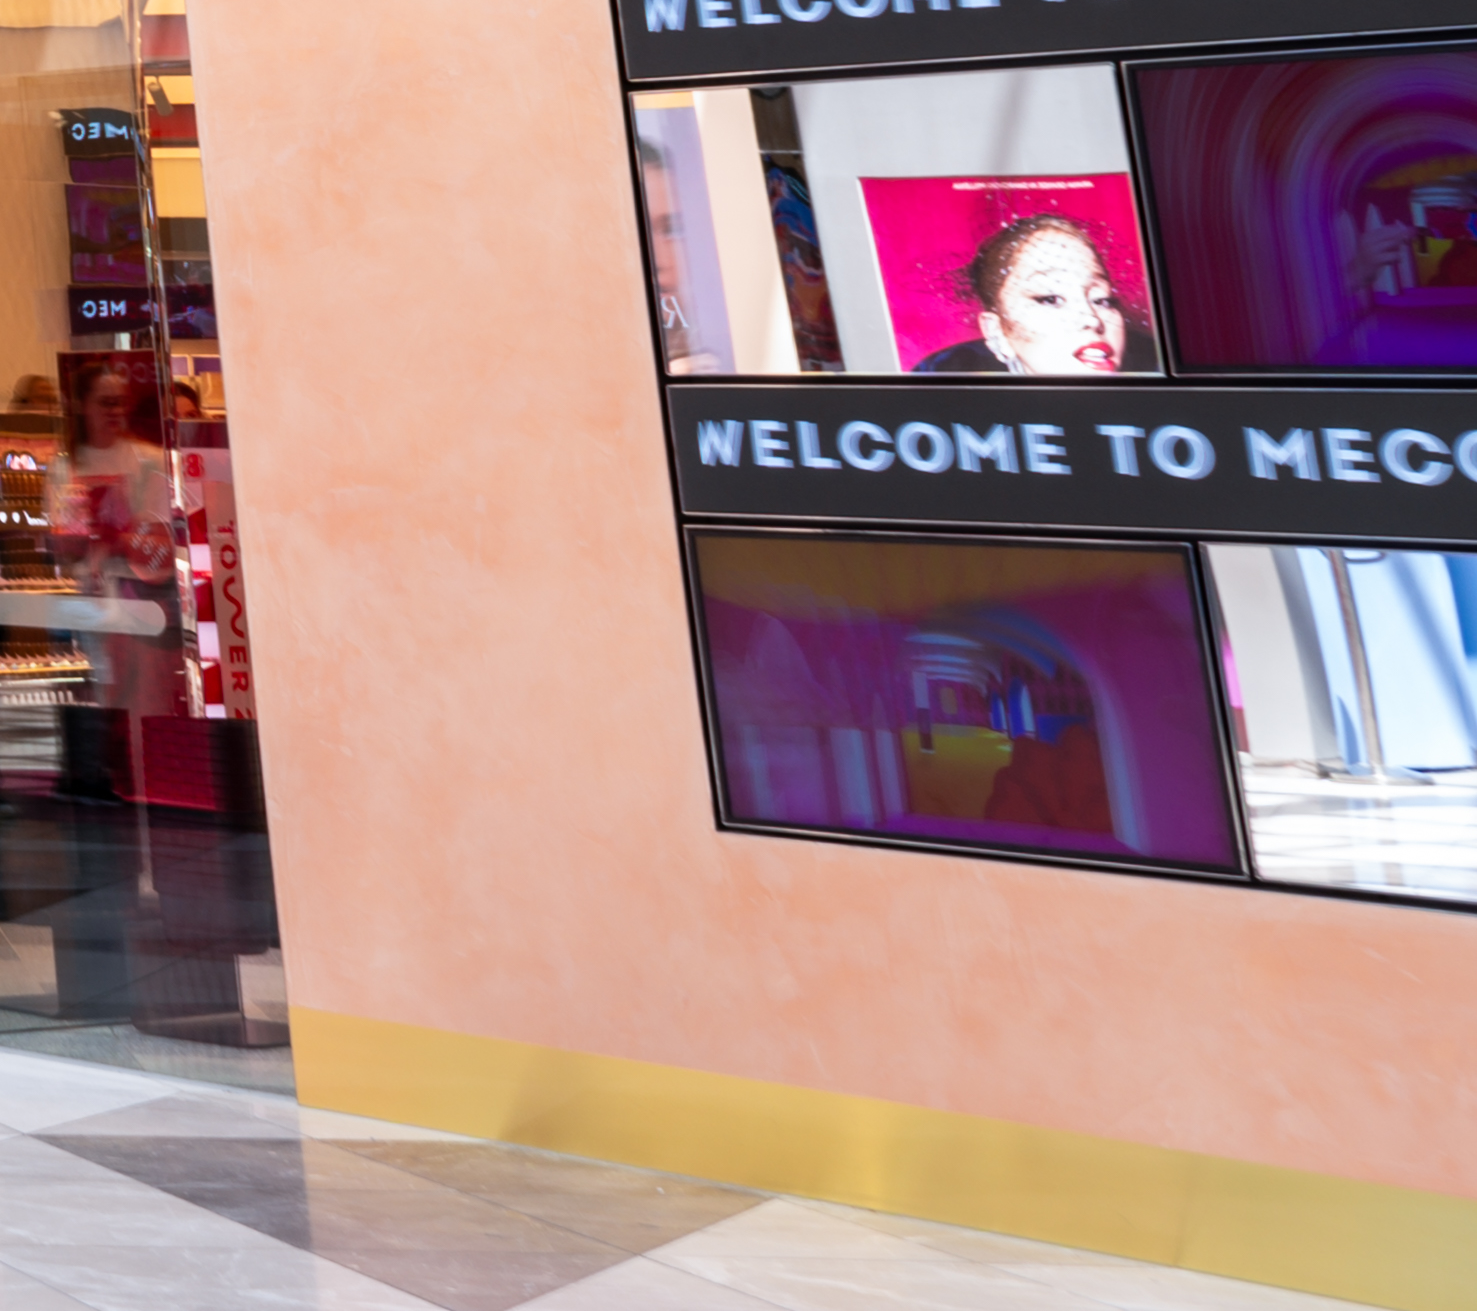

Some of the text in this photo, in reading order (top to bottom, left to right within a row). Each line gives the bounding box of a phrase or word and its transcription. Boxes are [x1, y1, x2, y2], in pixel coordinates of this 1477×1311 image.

[696, 420, 1073, 475] WELCOME
[1096, 424, 1217, 481] TO
[219, 519, 250, 693] TOWER
